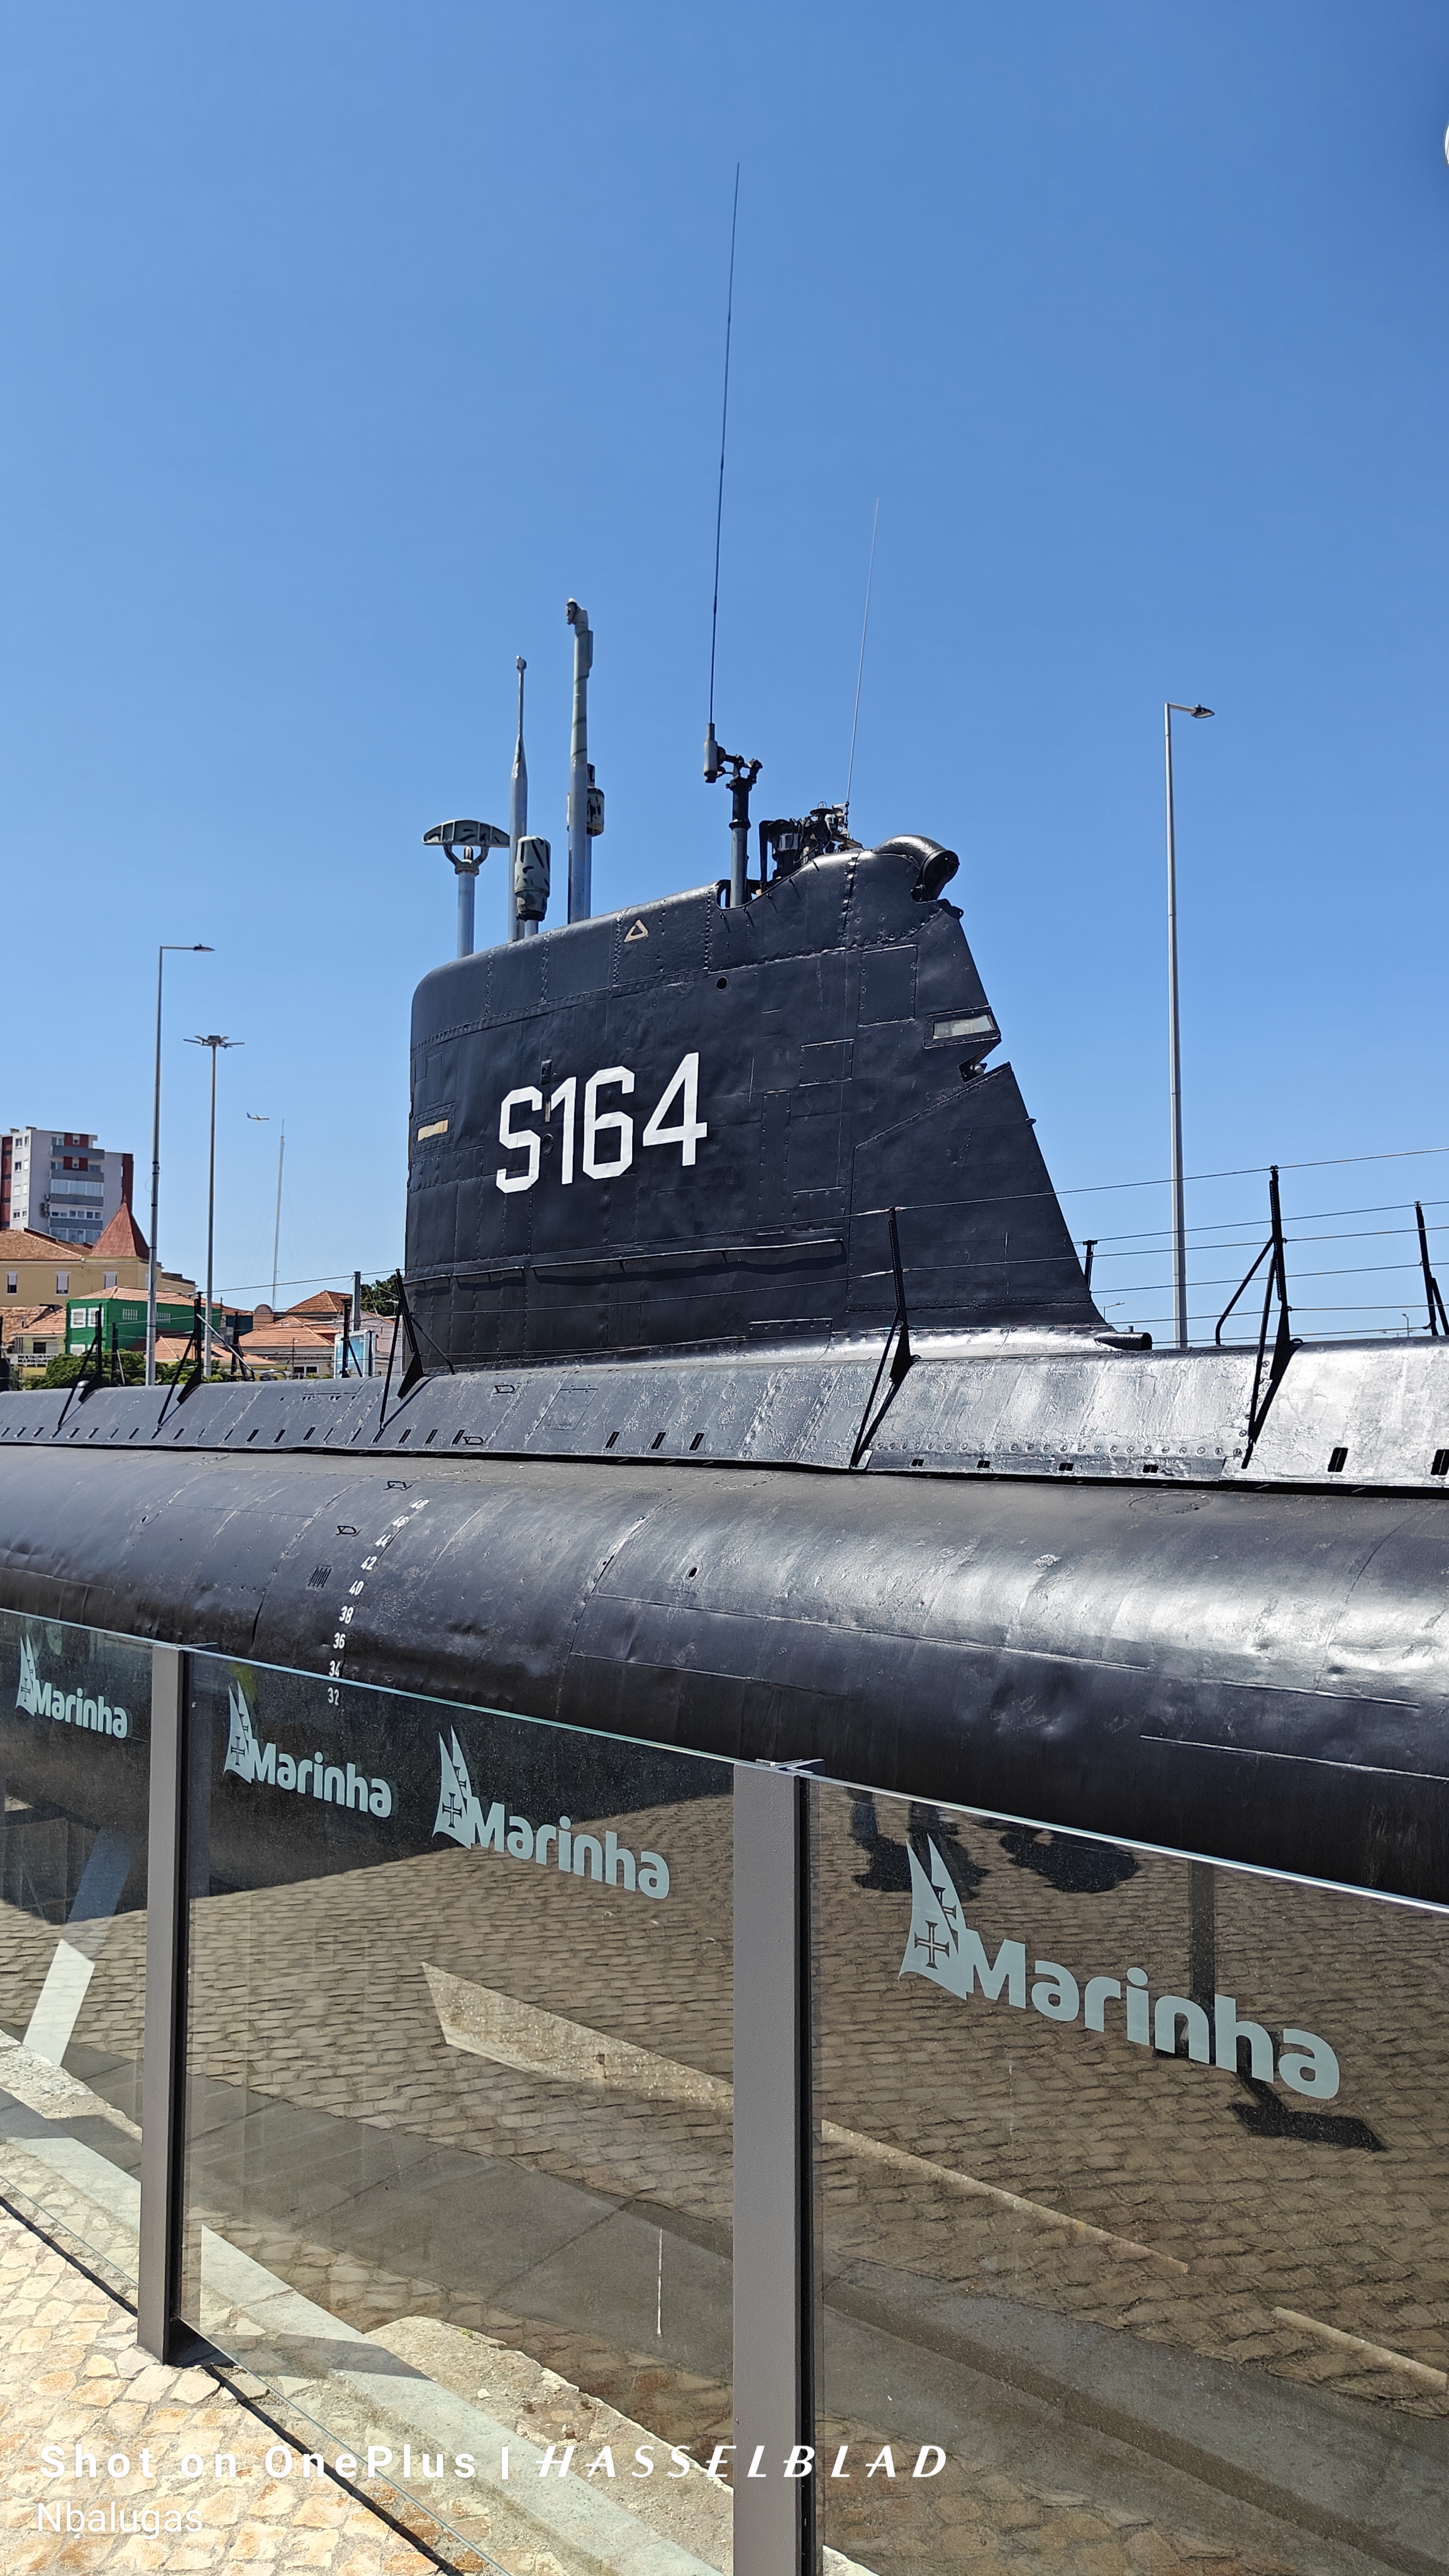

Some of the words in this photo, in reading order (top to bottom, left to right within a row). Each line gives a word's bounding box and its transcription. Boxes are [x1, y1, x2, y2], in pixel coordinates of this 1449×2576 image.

[496, 1052, 708, 1194] S164
[410, 1499, 430, 1510] 48
[391, 1514, 409, 1528] 46
[374, 1534, 392, 1548] 44
[360, 1555, 377, 1570] 42
[348, 1580, 364, 1596] 40
[339, 1605, 354, 1624] 38
[333, 1632, 346, 1649] 36
[328, 1660, 341, 1677] 34
[327, 1687, 340, 1706] 32
[34, 1680, 128, 1739] Marinha
[252, 1738, 392, 1818] Marinha
[471, 1796, 670, 1899] Marinha
[965, 1928, 1340, 2099] Marinha
